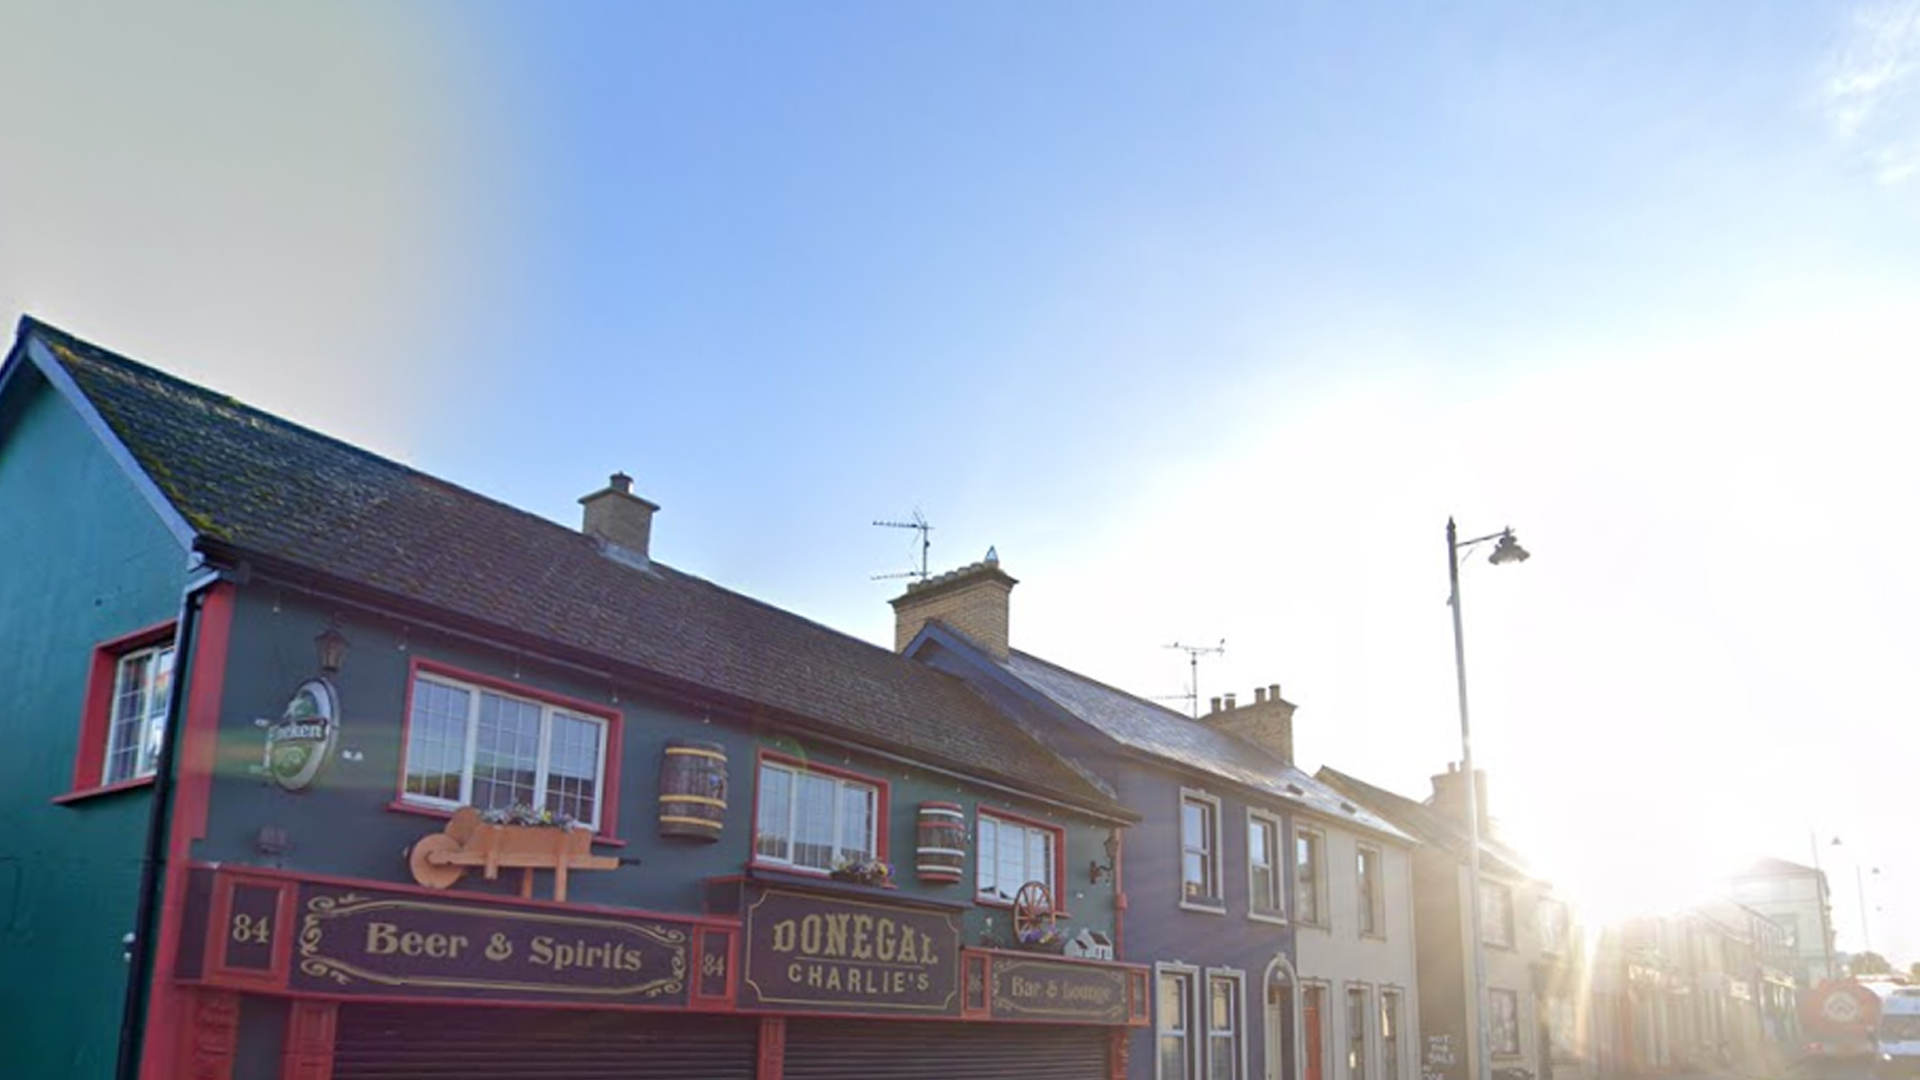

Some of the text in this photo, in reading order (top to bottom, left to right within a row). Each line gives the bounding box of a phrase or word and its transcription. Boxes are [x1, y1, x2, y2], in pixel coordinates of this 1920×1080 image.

[231, 913, 270, 944] 84
[772, 912, 939, 965] DONEGAL
[366, 922, 643, 972] Beer & Spirits
[702, 956, 726, 976] 84
[787, 962, 930, 994] CHARLIE'S
[1011, 976, 1042, 998] Bar
[1045, 980, 1058, 999] &
